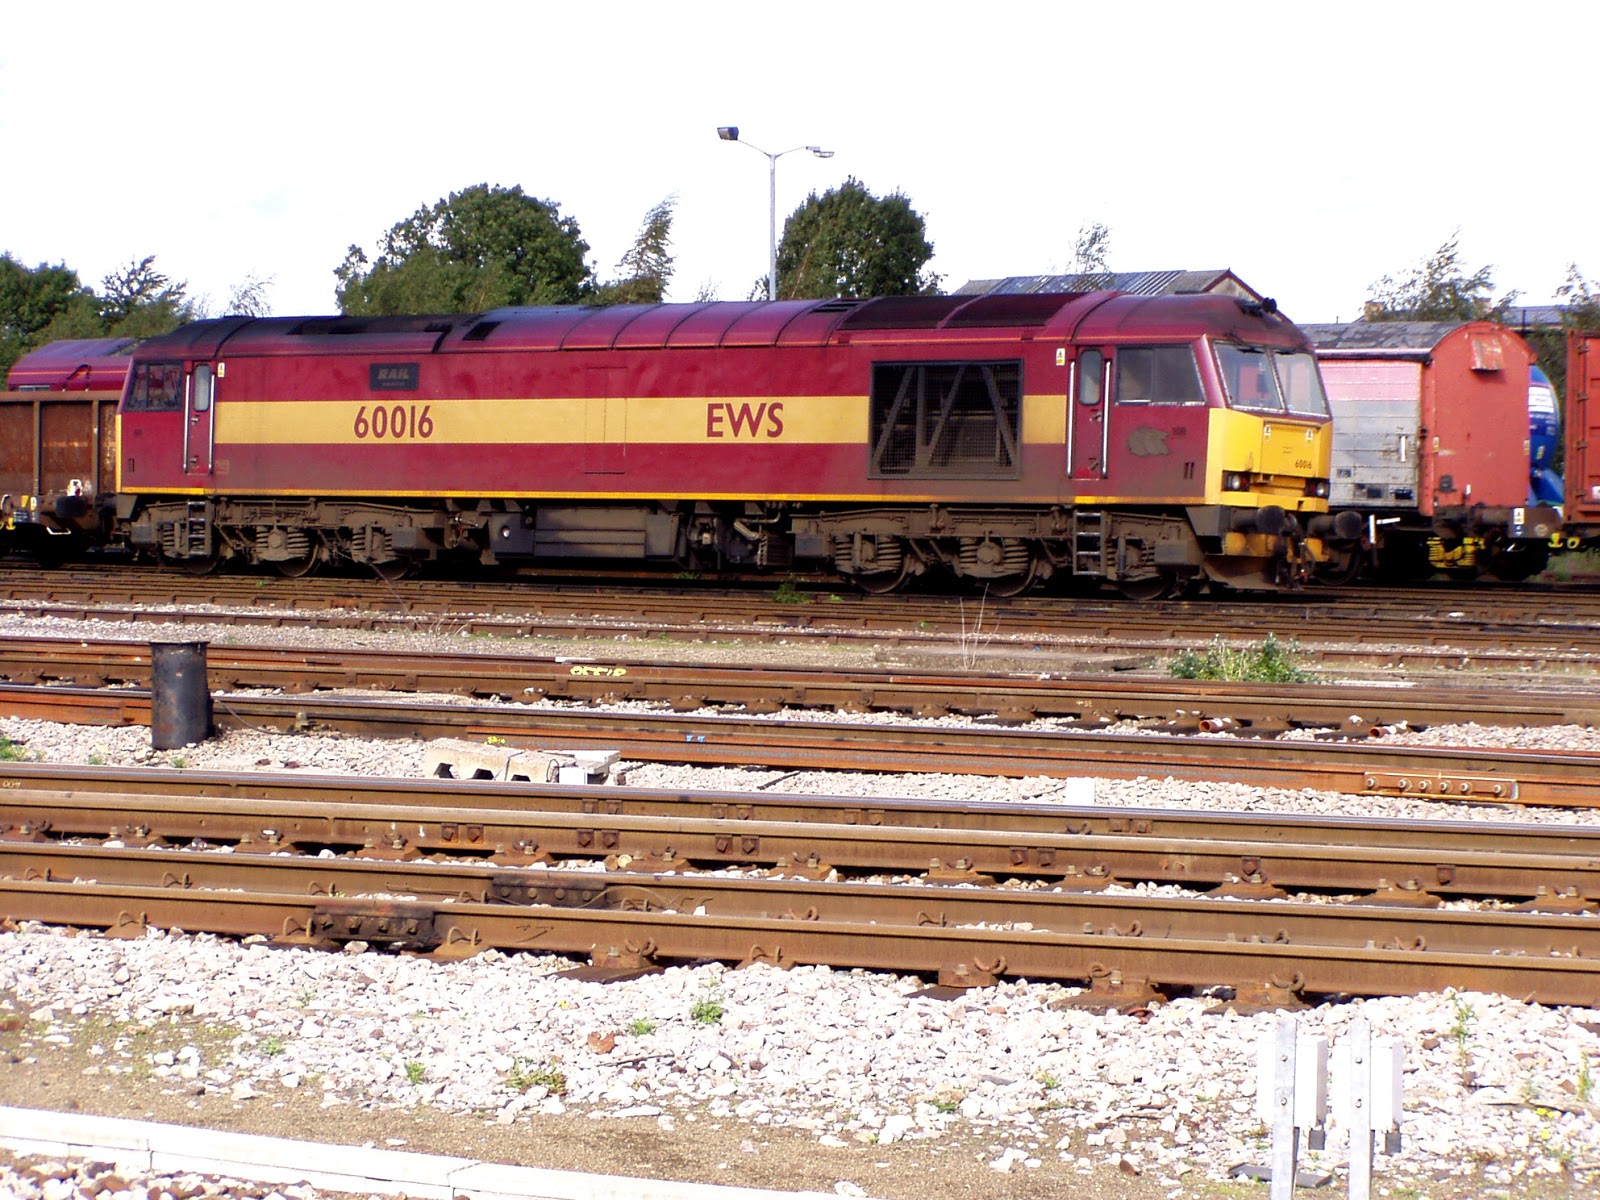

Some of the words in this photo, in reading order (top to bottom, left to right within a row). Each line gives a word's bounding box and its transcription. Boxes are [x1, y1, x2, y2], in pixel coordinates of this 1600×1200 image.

[377, 368, 409, 380] RAIL
[354, 405, 434, 438] 60016
[707, 402, 784, 438] EWS
[1295, 459, 1312, 470] 60016
